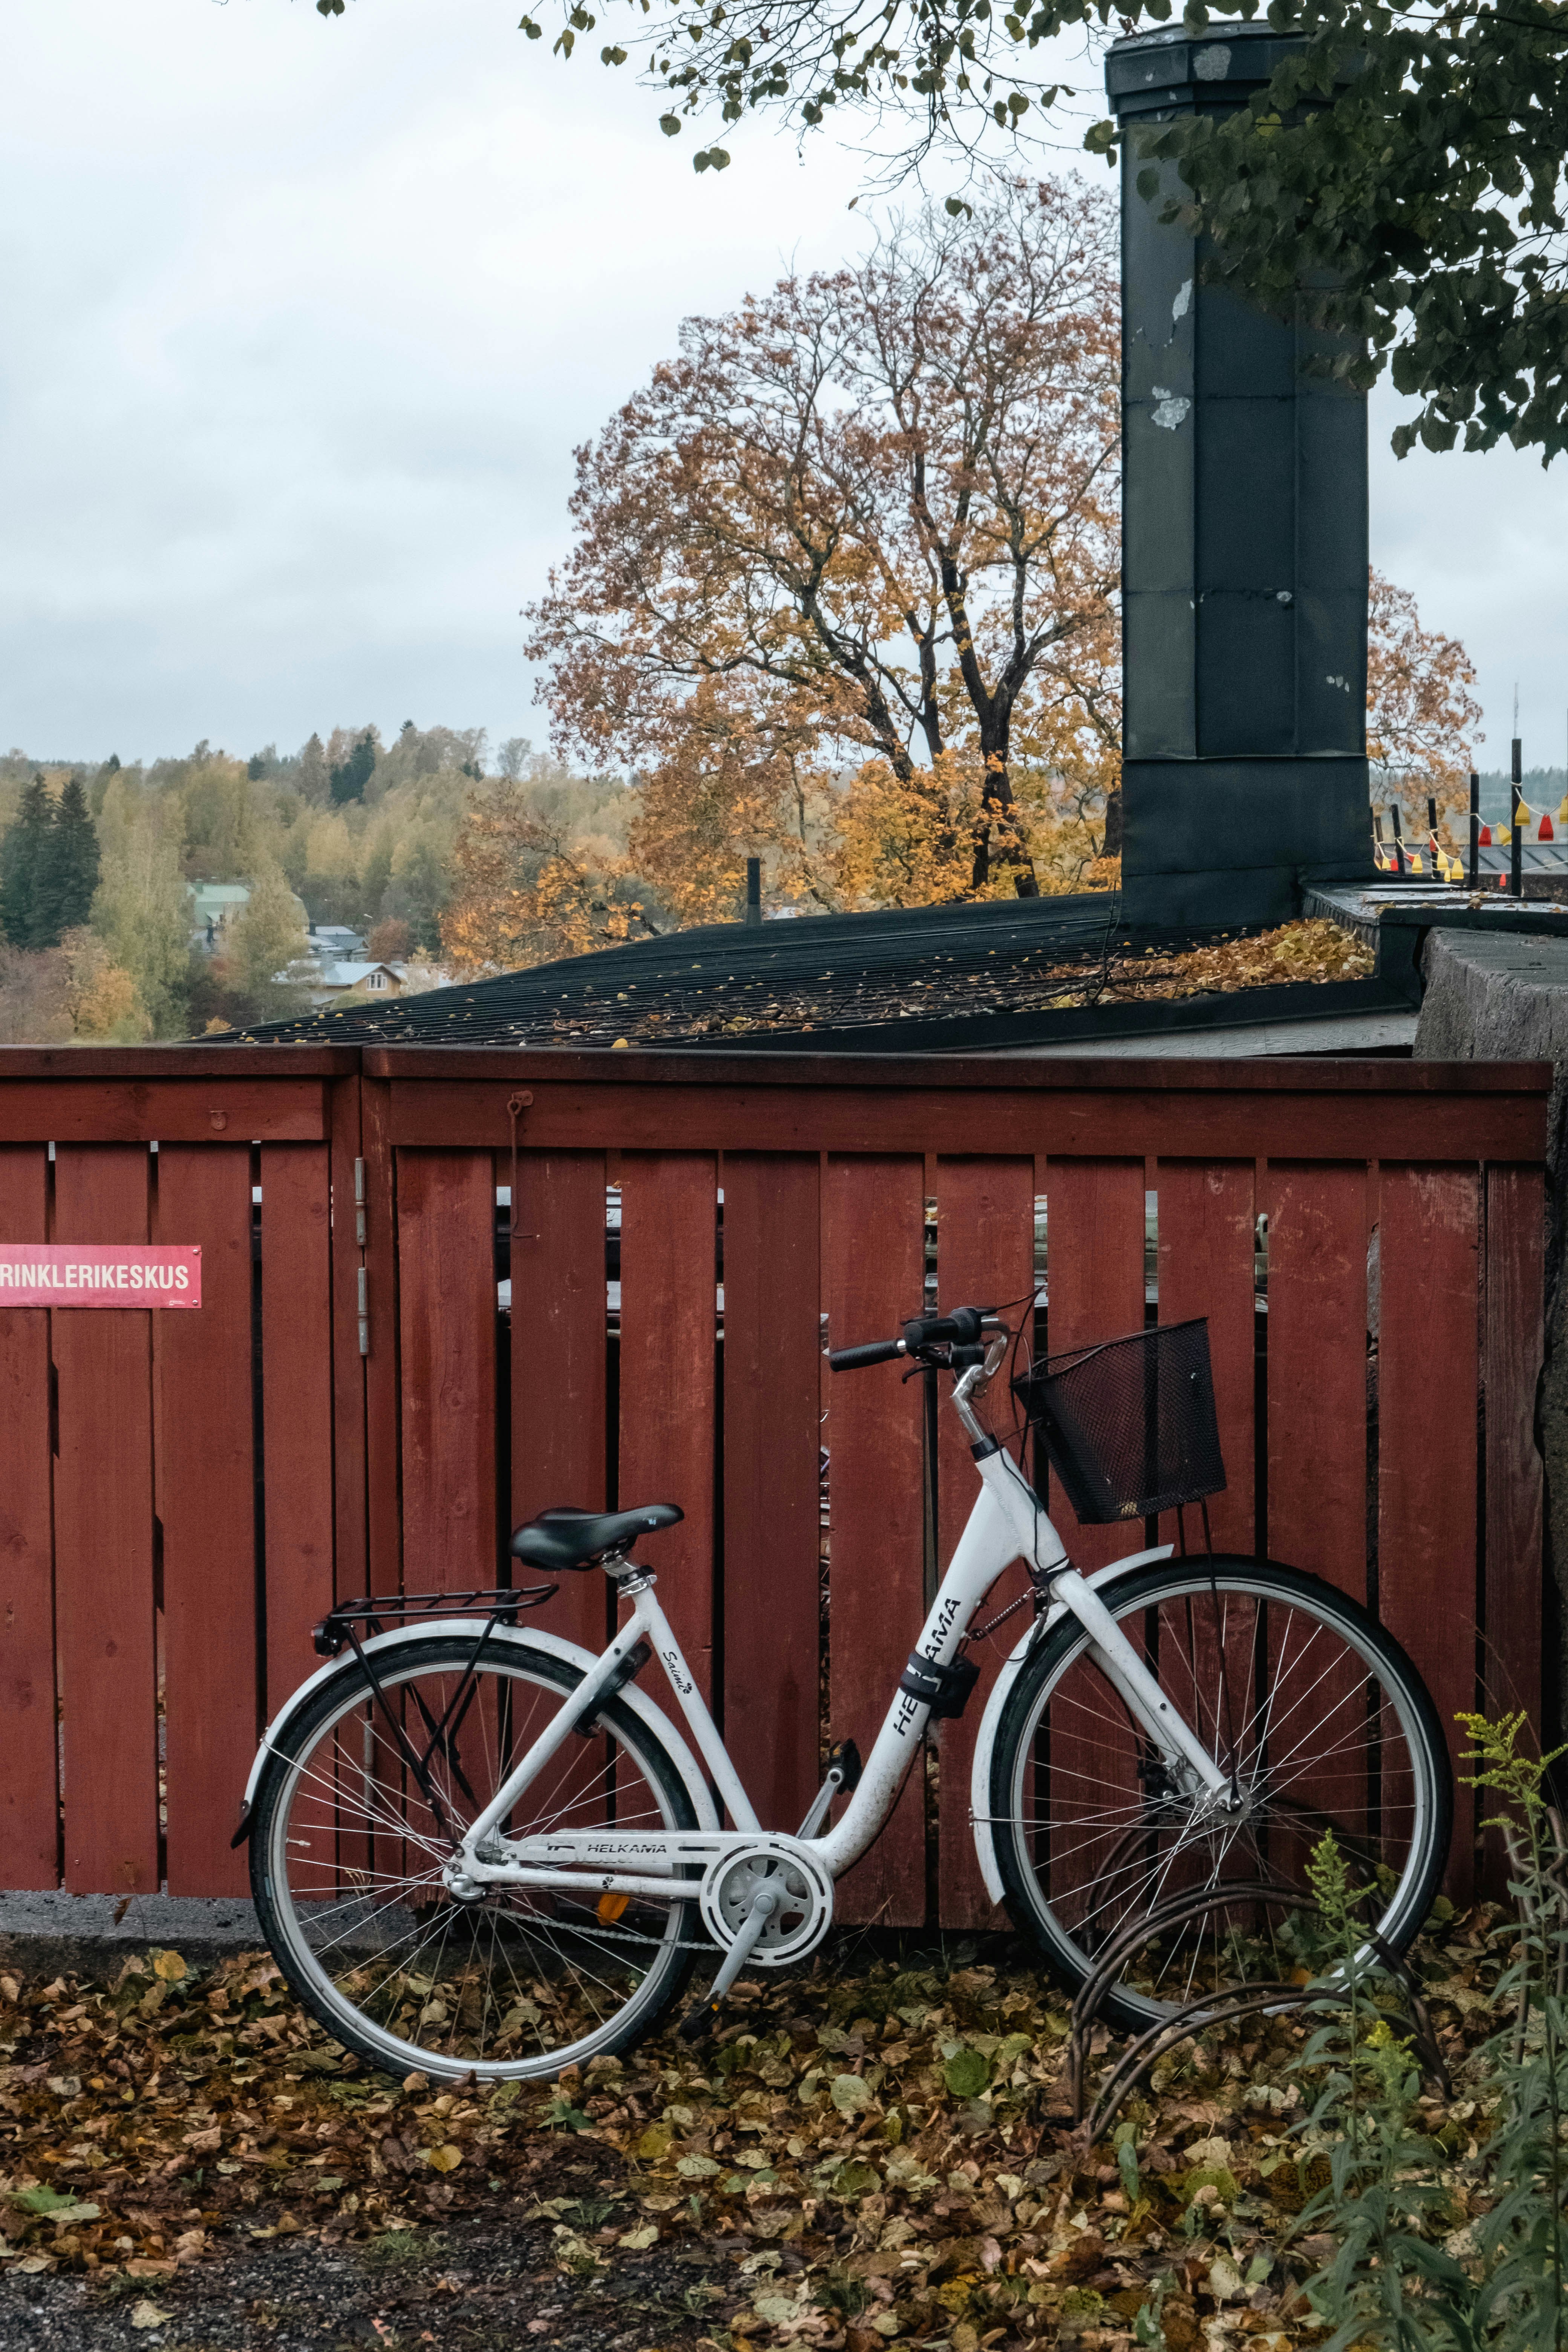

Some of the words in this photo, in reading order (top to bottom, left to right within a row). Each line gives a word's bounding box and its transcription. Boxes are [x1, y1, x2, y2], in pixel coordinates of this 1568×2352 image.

[0, 1264, 188, 1289] RINKLERIKESKUS
[893, 1598, 961, 1736] HEAMA
[587, 1844, 666, 1853] HELKAMA
